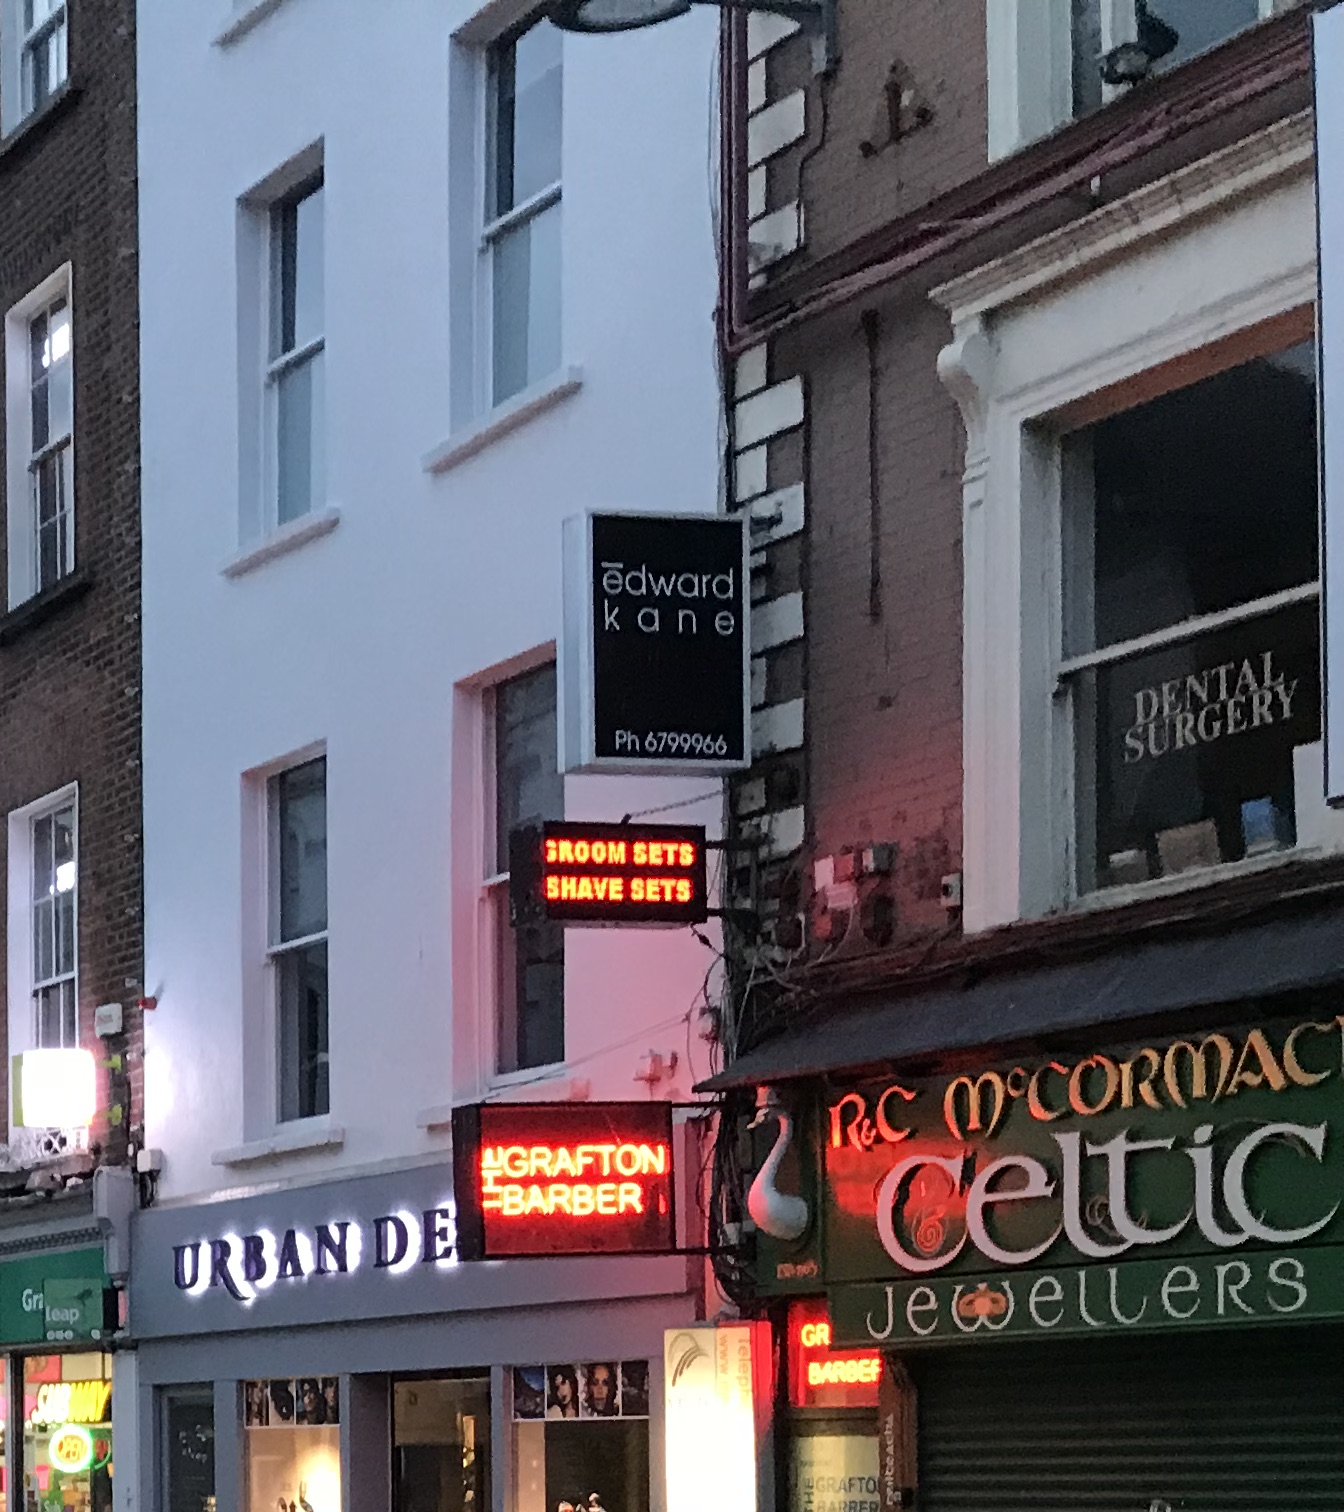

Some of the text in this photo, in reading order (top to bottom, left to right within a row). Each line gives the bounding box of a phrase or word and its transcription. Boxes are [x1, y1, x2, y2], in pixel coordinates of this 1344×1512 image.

[1134, 651, 1285, 727] DENTAL
[615, 730, 727, 756] Ph 6799966
[1123, 680, 1298, 764] SURGERY
[633, 842, 693, 866] SETS
[547, 876, 691, 902] SHAVE SETS
[482, 1144, 665, 1209] THE GRAFTON
[502, 1183, 643, 1216] BARBER
[172, 1207, 457, 1301] URBAN DE
[31, 1382, 111, 1424] SUBWAY
